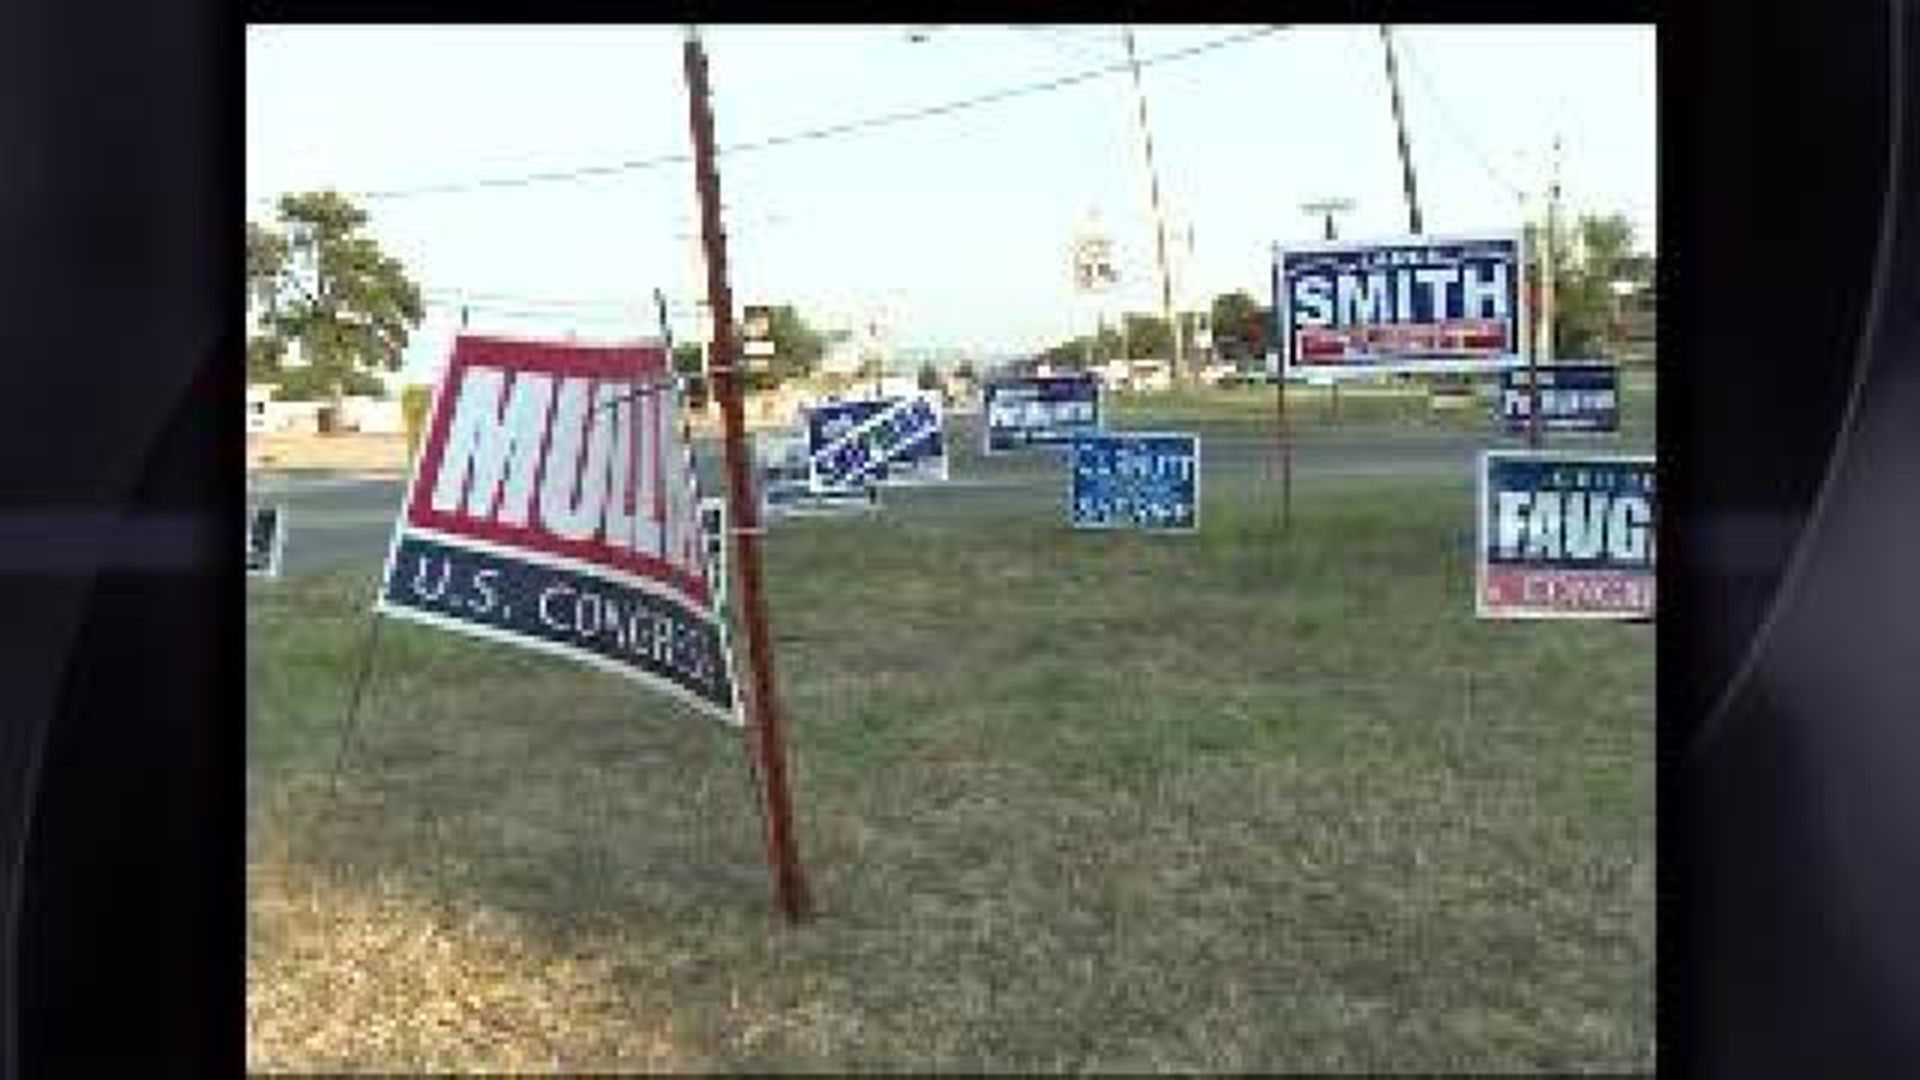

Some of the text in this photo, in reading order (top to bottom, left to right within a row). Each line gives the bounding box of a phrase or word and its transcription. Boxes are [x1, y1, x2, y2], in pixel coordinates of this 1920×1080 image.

[1295, 264, 1511, 327] SMITH
[1498, 490, 1652, 560] FAUG
[412, 556, 511, 619] U.S.
